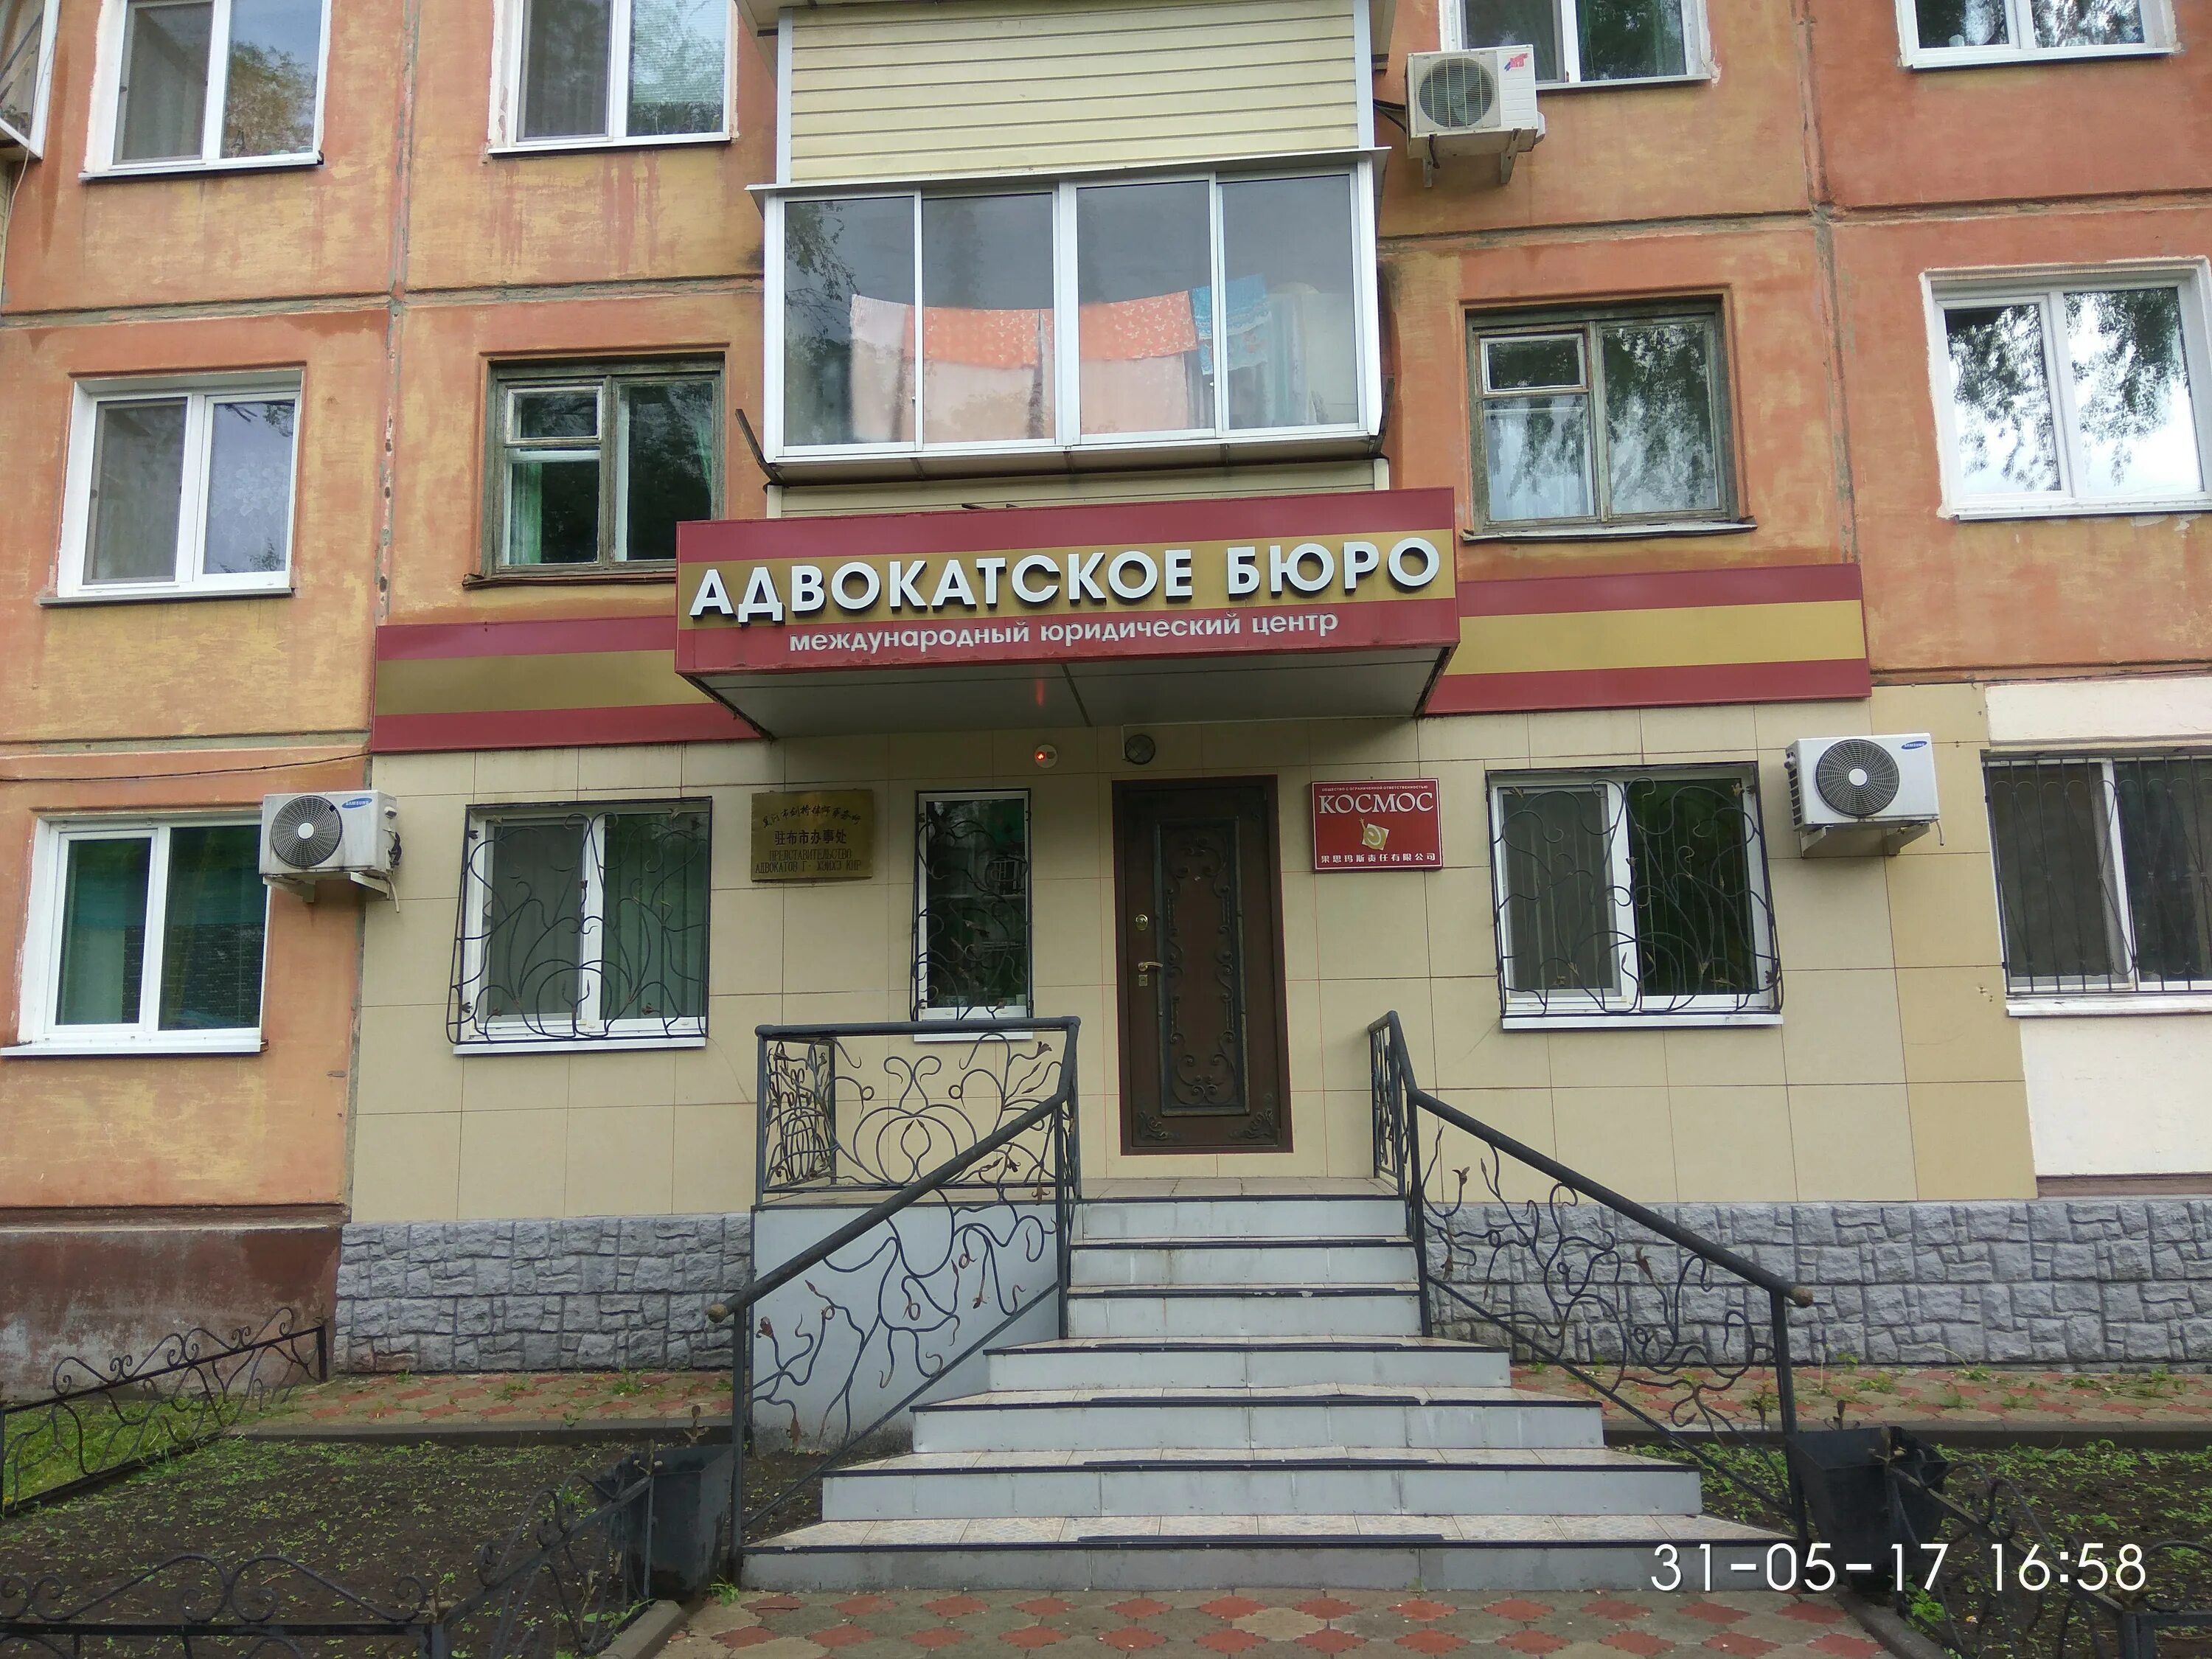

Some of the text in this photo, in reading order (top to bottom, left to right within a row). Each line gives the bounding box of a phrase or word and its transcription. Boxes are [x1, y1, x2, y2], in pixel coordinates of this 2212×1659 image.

[689, 537, 1441, 623] АДВОКАТСКОЕ БЮРО
[789, 611, 1340, 653] международный юридический центр
[1318, 792, 1434, 814] КОСМОС
[774, 829, 846, 846] 驻布市办事处
[769, 849, 852, 861] ПРЕДСТАВИТЕЛЬСТВО
[755, 860, 798, 873] АДВОКАТОВ
